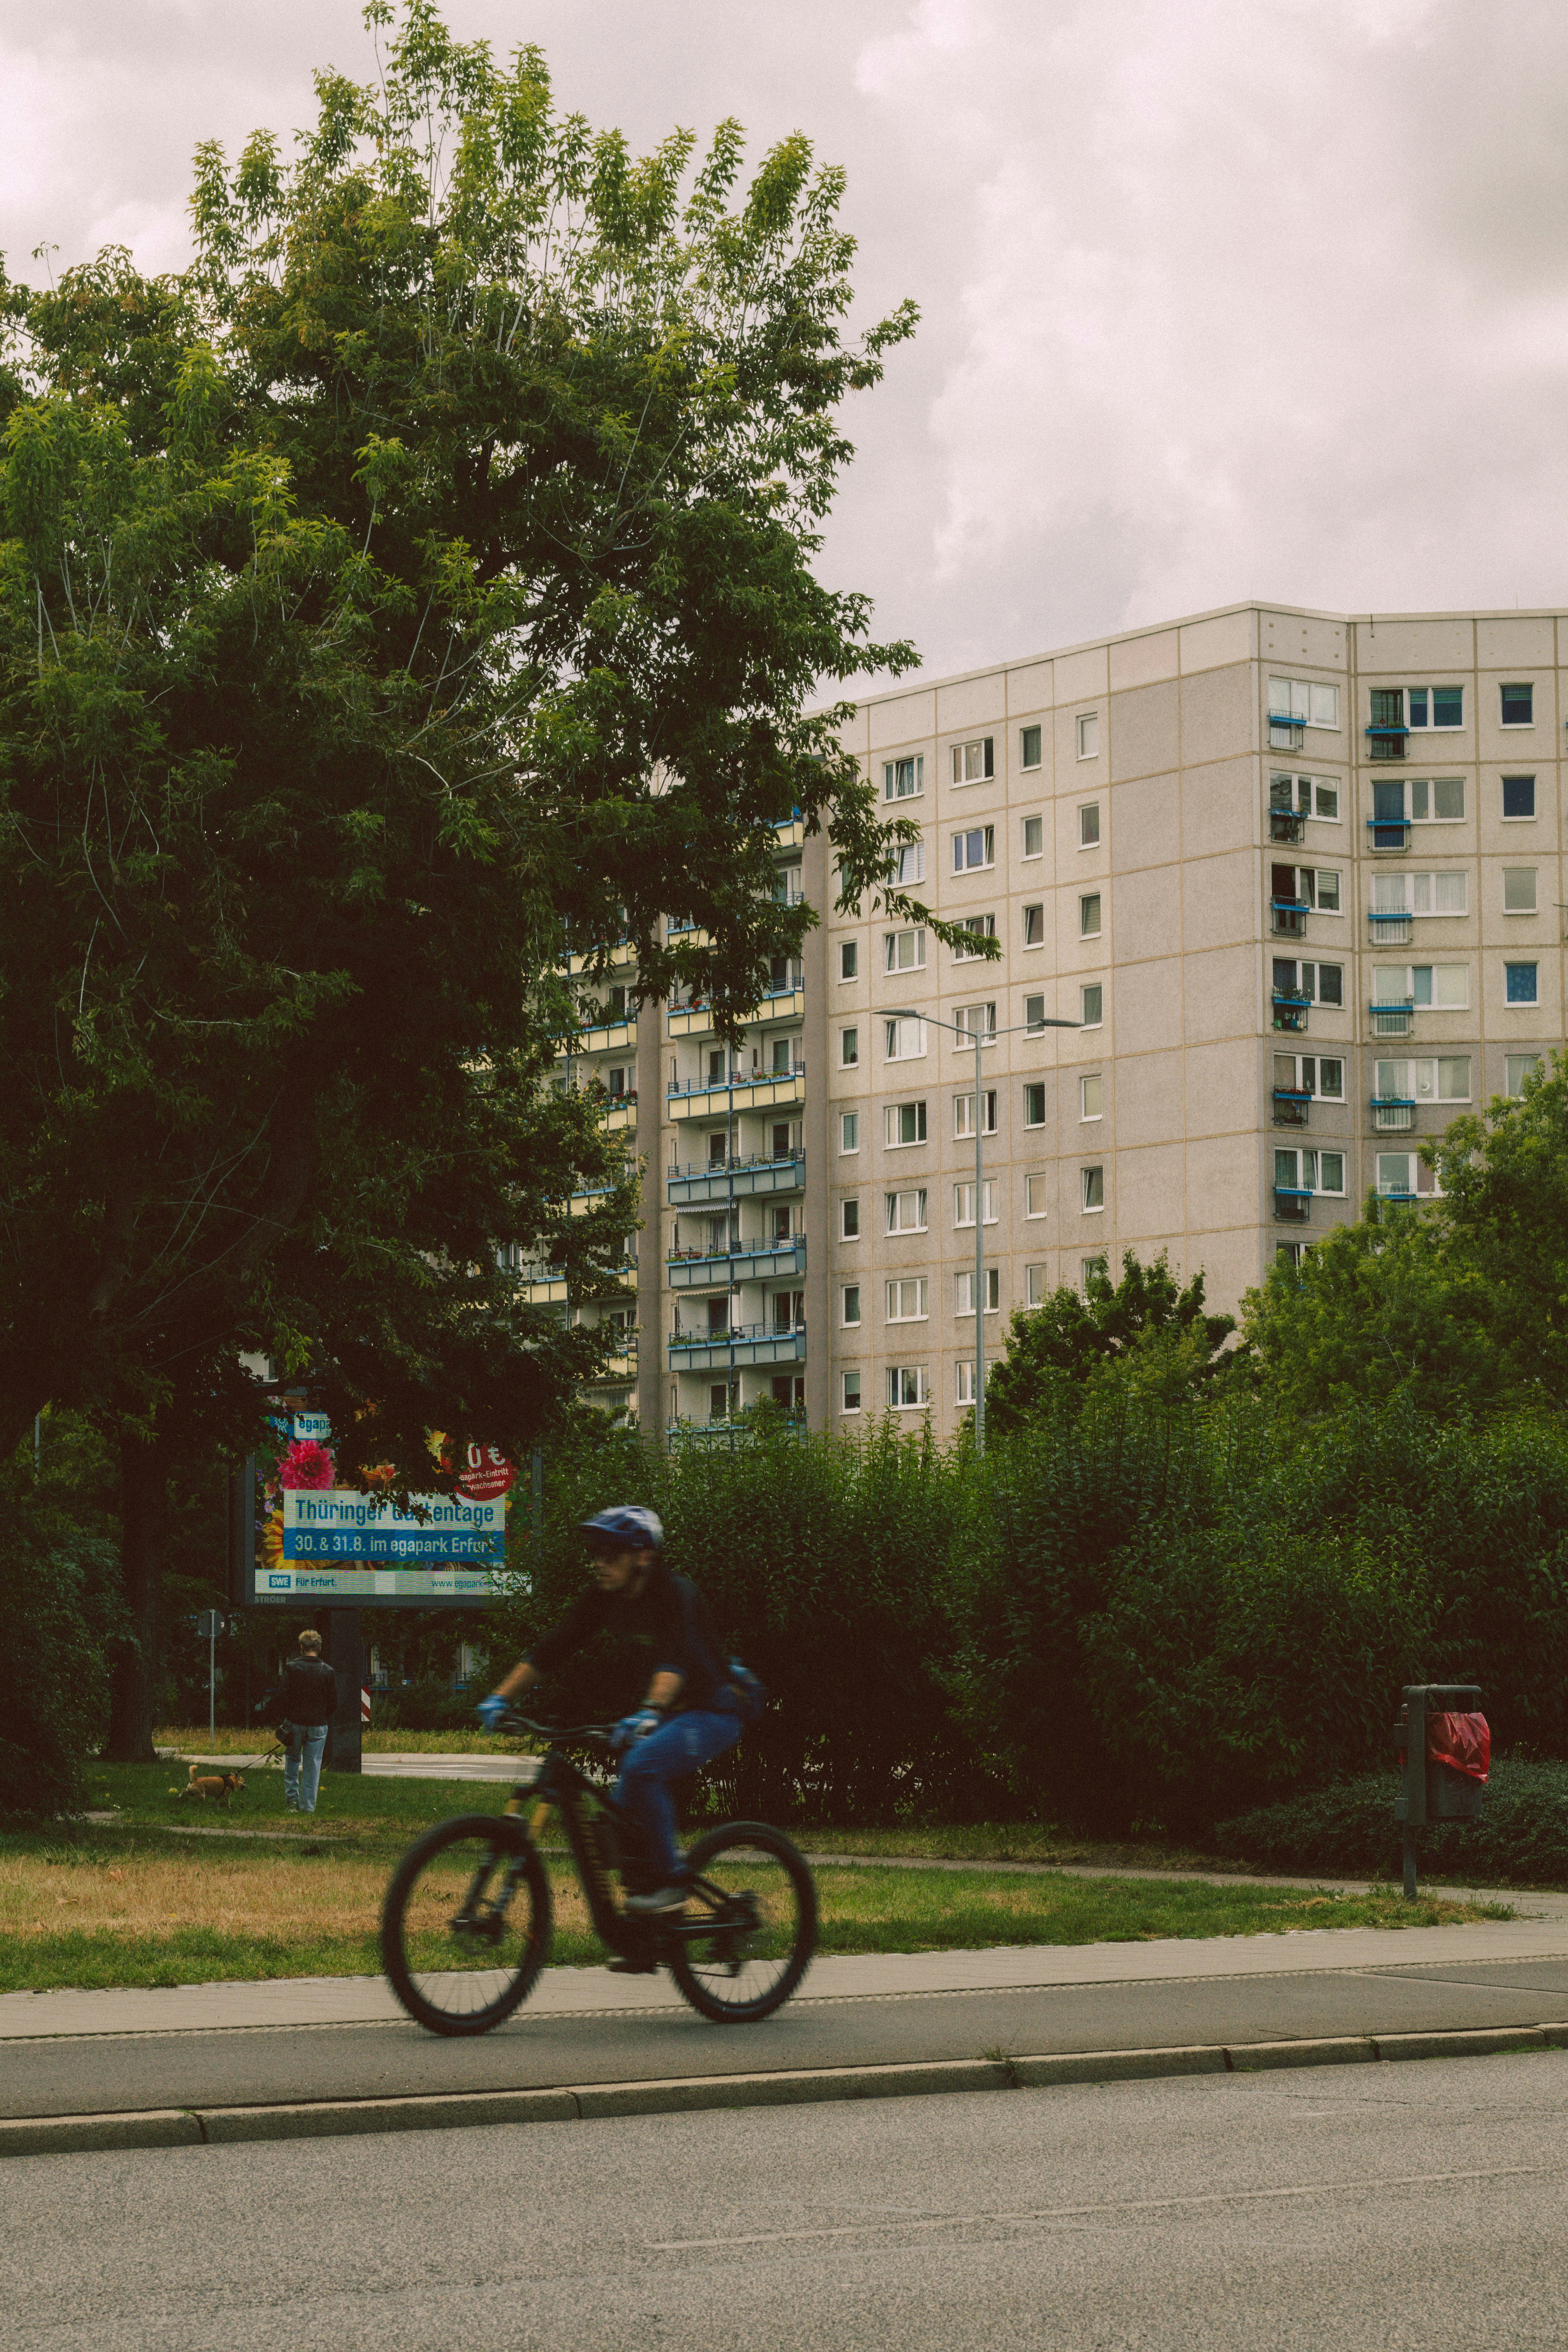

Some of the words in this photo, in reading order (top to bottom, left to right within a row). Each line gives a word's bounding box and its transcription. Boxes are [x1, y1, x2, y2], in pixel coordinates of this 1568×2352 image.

[299, 1419, 331, 1432] egapa
[467, 1443, 482, 1468] 0
[459, 1468, 509, 1482] gapark-Eintritt
[465, 1480, 506, 1491] wachsener
[296, 1499, 387, 1526] Thüringer
[392, 1501, 494, 1527] Gatentage
[295, 1535, 317, 1551] 30.
[319, 1536, 328, 1551] &
[333, 1536, 366, 1552] 31.8.
[370, 1536, 387, 1552] im
[390, 1537, 448, 1556] egapark
[452, 1537, 495, 1553] Erfurt
[271, 1577, 289, 1586] SWE
[296, 1577, 309, 1586] Für
